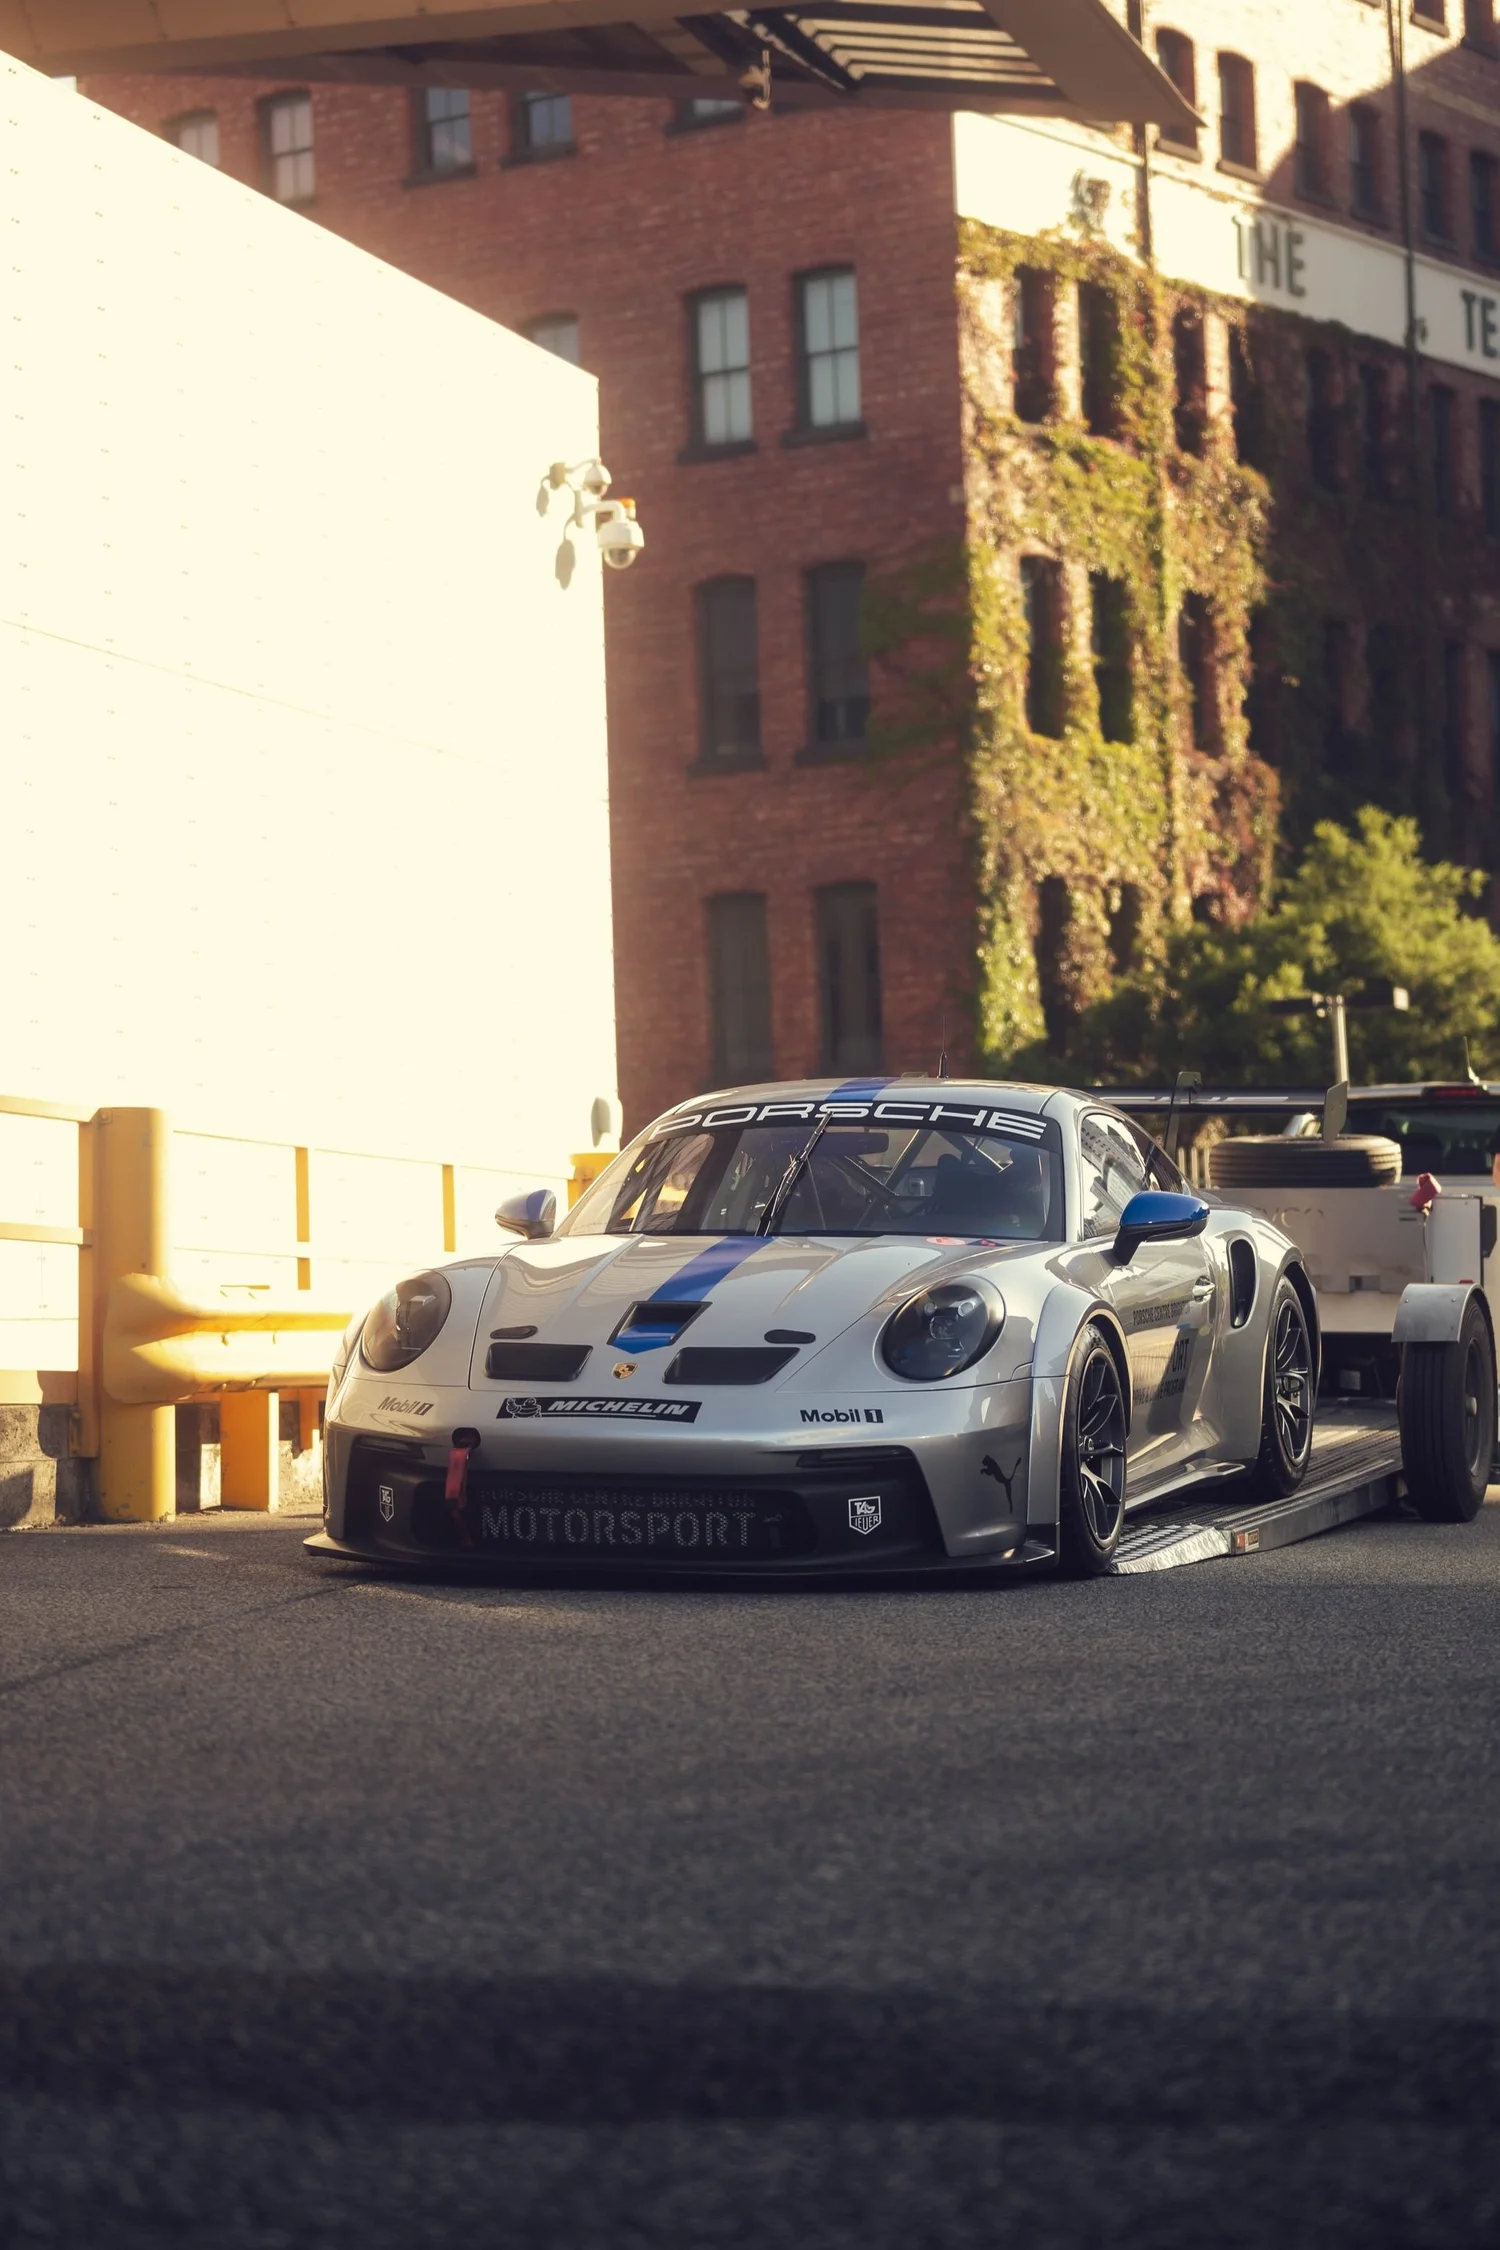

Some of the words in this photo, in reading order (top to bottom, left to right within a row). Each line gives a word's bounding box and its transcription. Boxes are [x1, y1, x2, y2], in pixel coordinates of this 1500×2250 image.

[1231, 213, 1306, 298] THE
[647, 1102, 1047, 1141] PORSCHE
[377, 1396, 421, 1414] Mobil
[413, 1402, 434, 1416] 1
[547, 1400, 689, 1416] MICHELIN
[800, 1409, 861, 1423] Mobil
[865, 1409, 884, 1424] 1
[854, 1501, 876, 1515] TAG
[482, 1505, 756, 1546] MOTORSPORT
